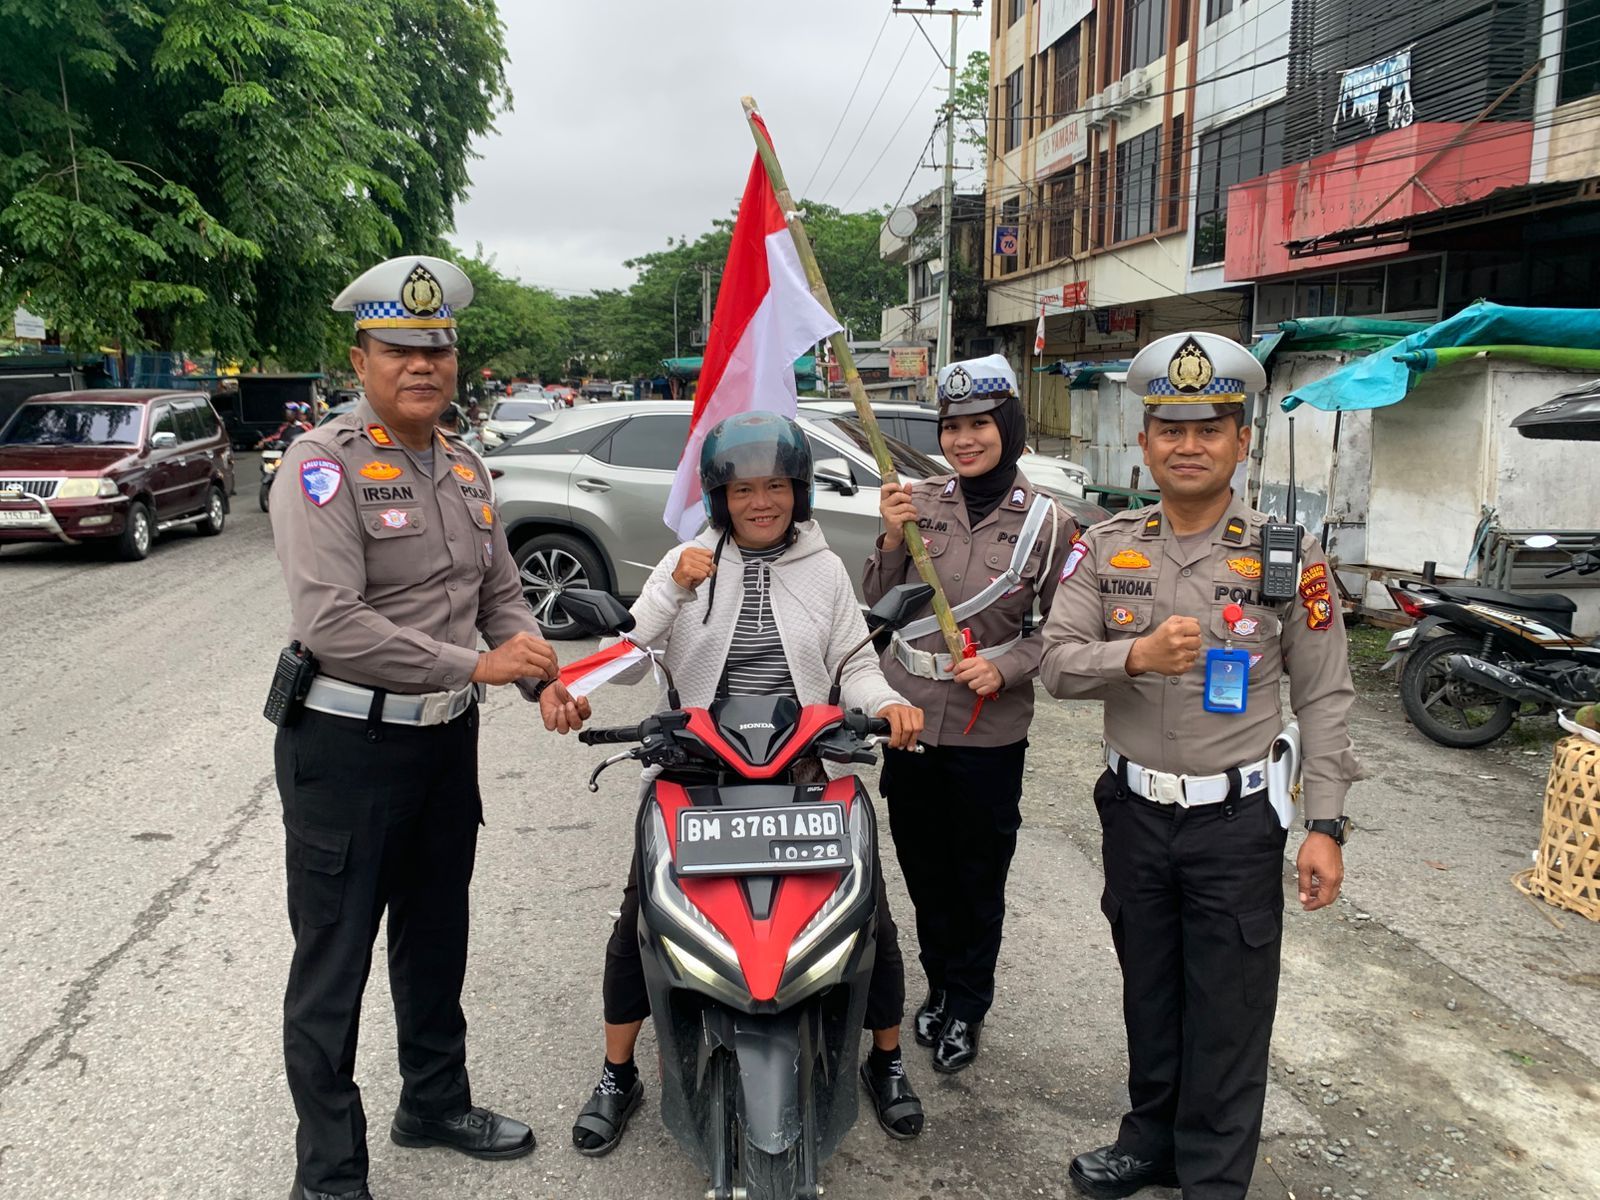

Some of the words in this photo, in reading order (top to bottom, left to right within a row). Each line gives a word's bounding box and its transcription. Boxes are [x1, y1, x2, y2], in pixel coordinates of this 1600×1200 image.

[1051, 122, 1079, 152] YAMAHA
[362, 486, 414, 502] IRSAN
[916, 517, 948, 532] CI.M
[997, 531, 1043, 552] POI
[1099, 578, 1153, 596] M.THOHA
[1305, 582, 1326, 596] RIAU
[739, 722, 776, 730] HONDA
[687, 818, 721, 842] BM
[731, 813, 788, 838] 3761
[793, 811, 838, 836] ABD
